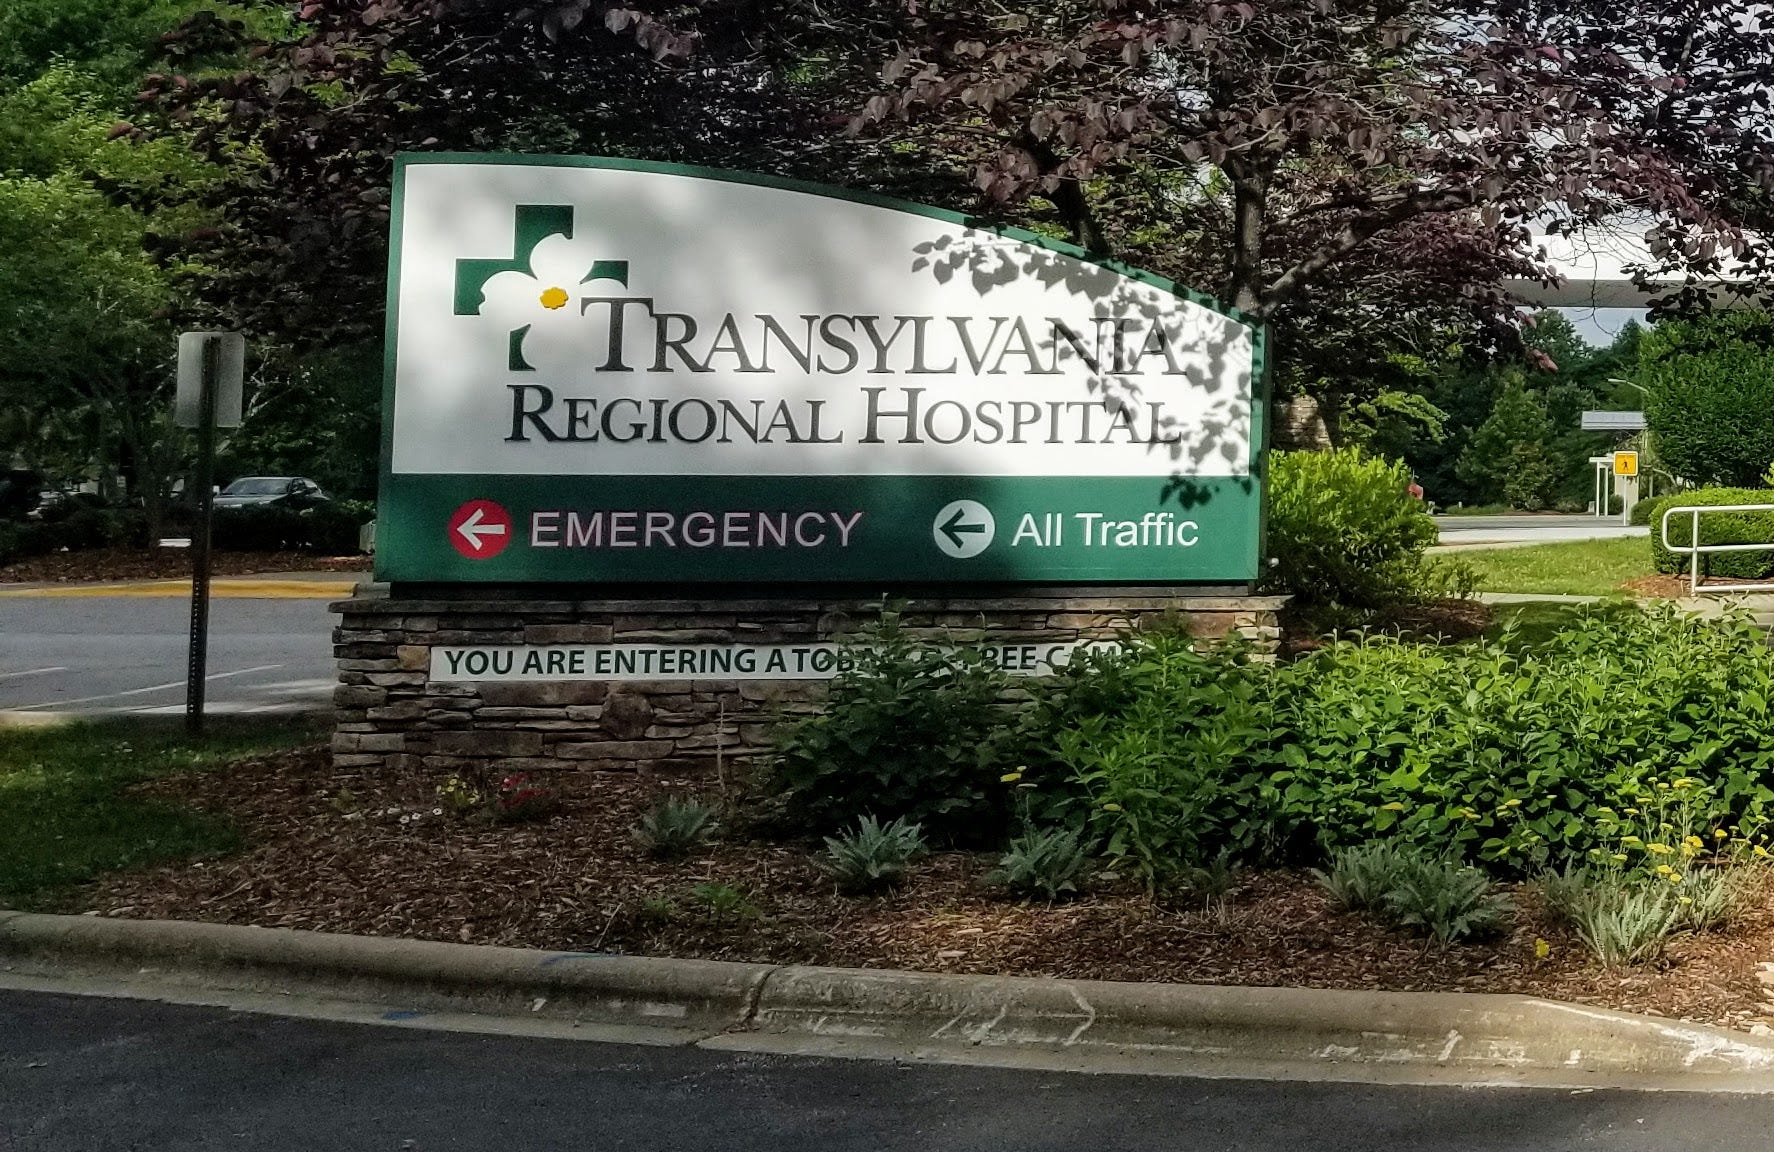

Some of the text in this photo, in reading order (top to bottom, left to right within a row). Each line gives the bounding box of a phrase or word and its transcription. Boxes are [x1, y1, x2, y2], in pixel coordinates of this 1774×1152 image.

[581, 297, 1187, 376] TRANSYLVANIA
[504, 384, 1182, 445] REGIONAL HOSPITAL
[531, 511, 863, 548] EMERGENCY
[1011, 512, 1199, 547] All Traffic
[445, 649, 513, 676] YOU
[522, 649, 585, 675] ARE
[595, 648, 756, 674] ENTERING
[765, 648, 787, 673] A
